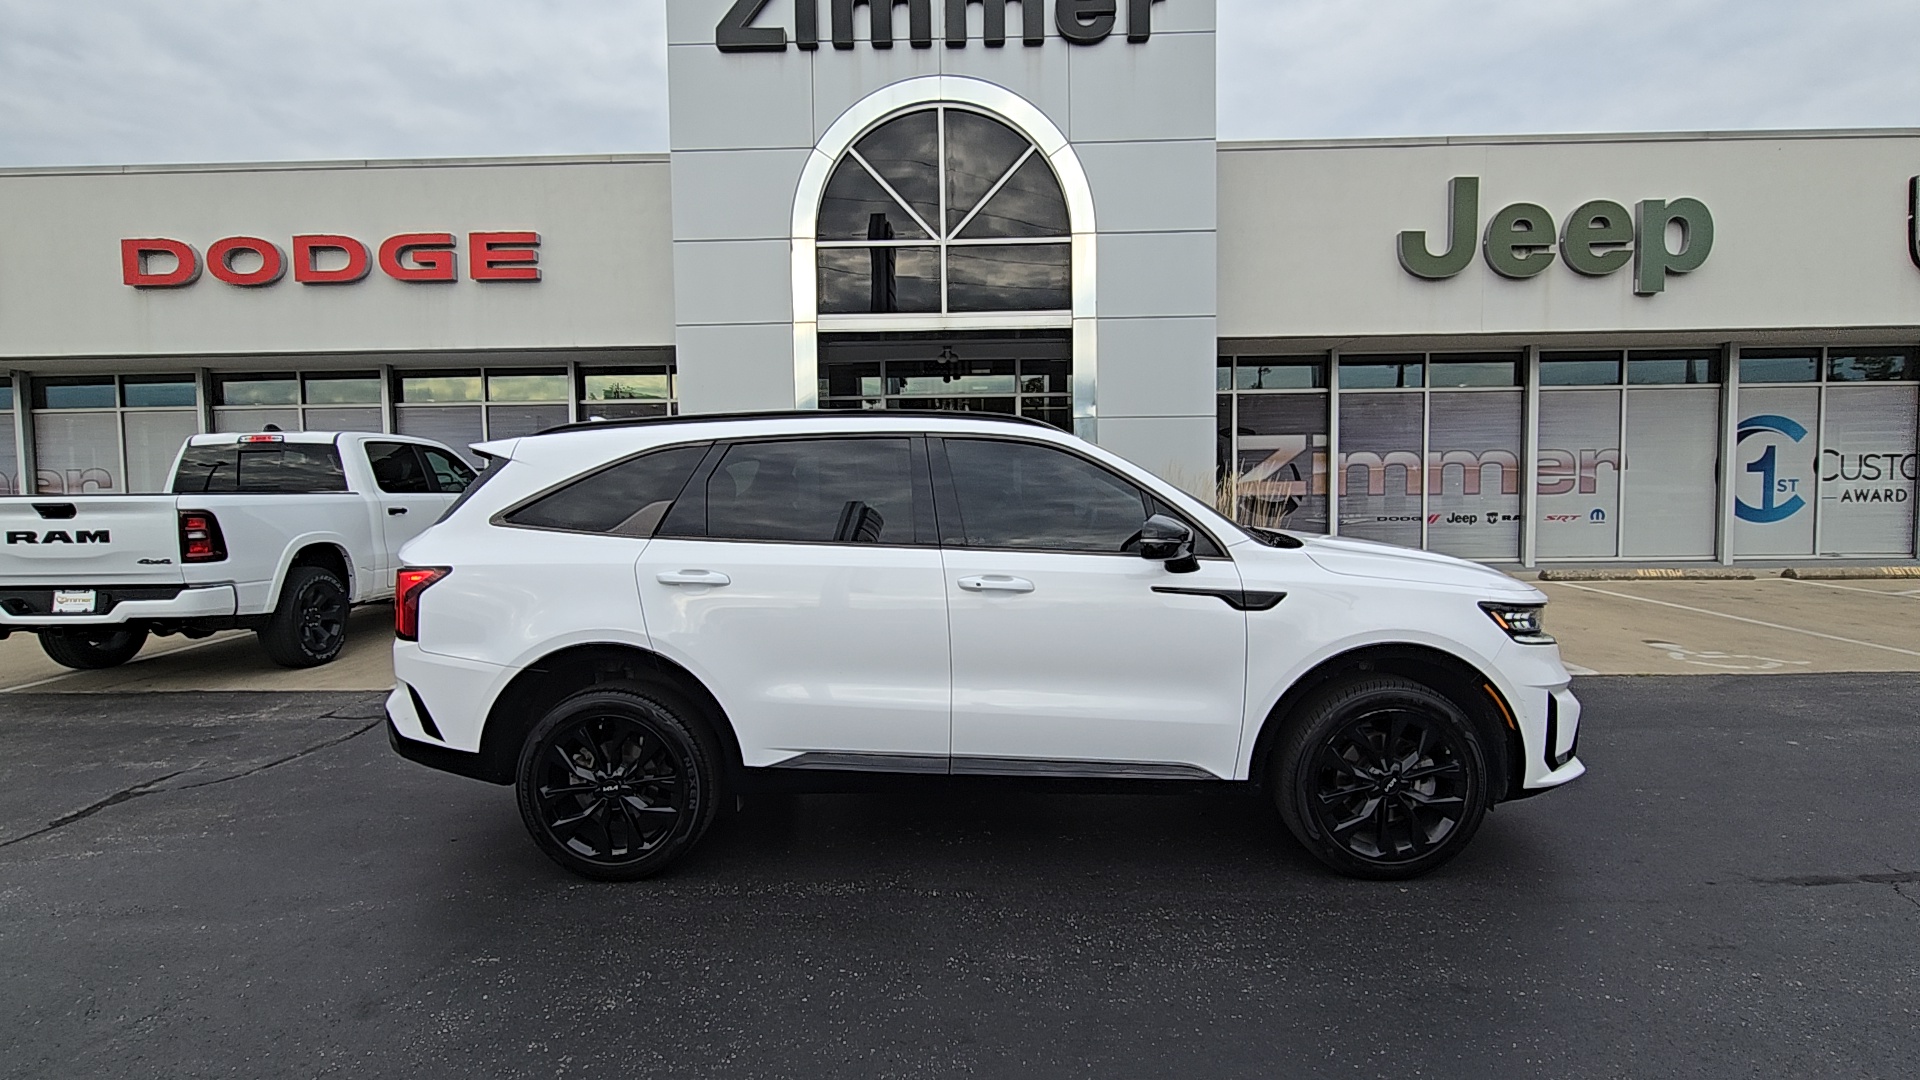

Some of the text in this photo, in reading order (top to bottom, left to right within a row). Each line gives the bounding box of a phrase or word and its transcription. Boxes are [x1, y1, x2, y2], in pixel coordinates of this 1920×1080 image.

[1396, 176, 1714, 297] Jeep
[120, 231, 541, 289] DODGE
[1236, 434, 1628, 496] Zimmer
[1840, 488, 1908, 503] AWARD
[1446, 512, 1478, 526] Jeep
[1543, 514, 1582, 523] SRT
[6, 530, 111, 544] RAM
[1880, 566, 1920, 576] VISITO
[683, 756, 697, 810] NEXEN
